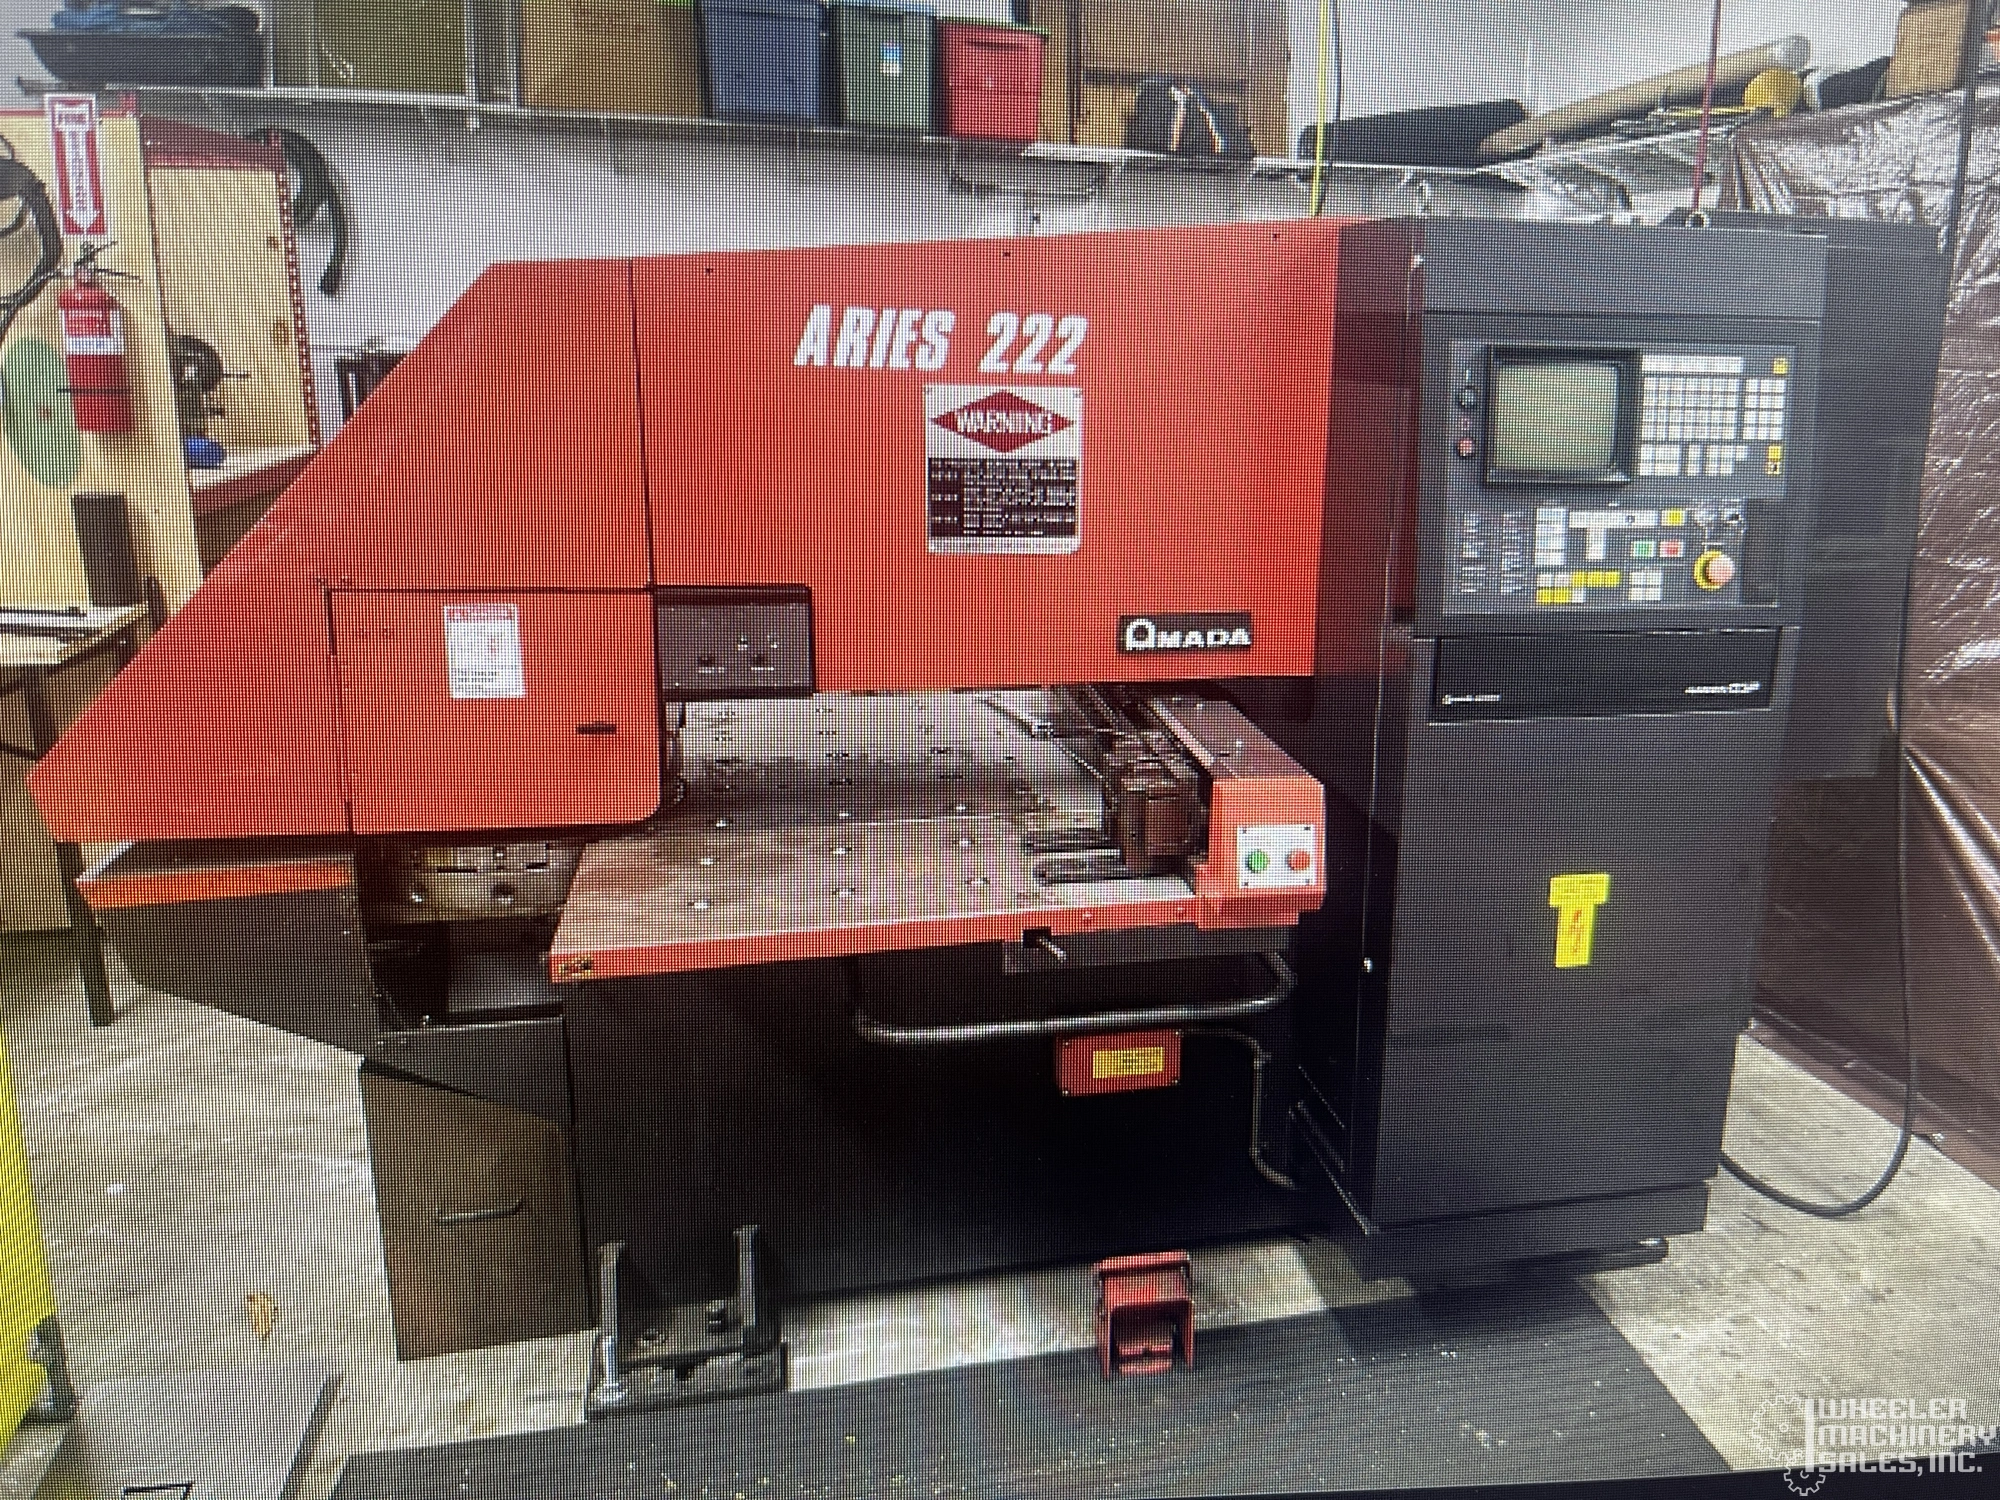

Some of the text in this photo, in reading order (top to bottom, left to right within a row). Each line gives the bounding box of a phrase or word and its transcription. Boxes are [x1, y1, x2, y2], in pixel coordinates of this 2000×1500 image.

[794, 304, 1088, 375] ARIES 222
[956, 410, 1053, 434] WARNING
